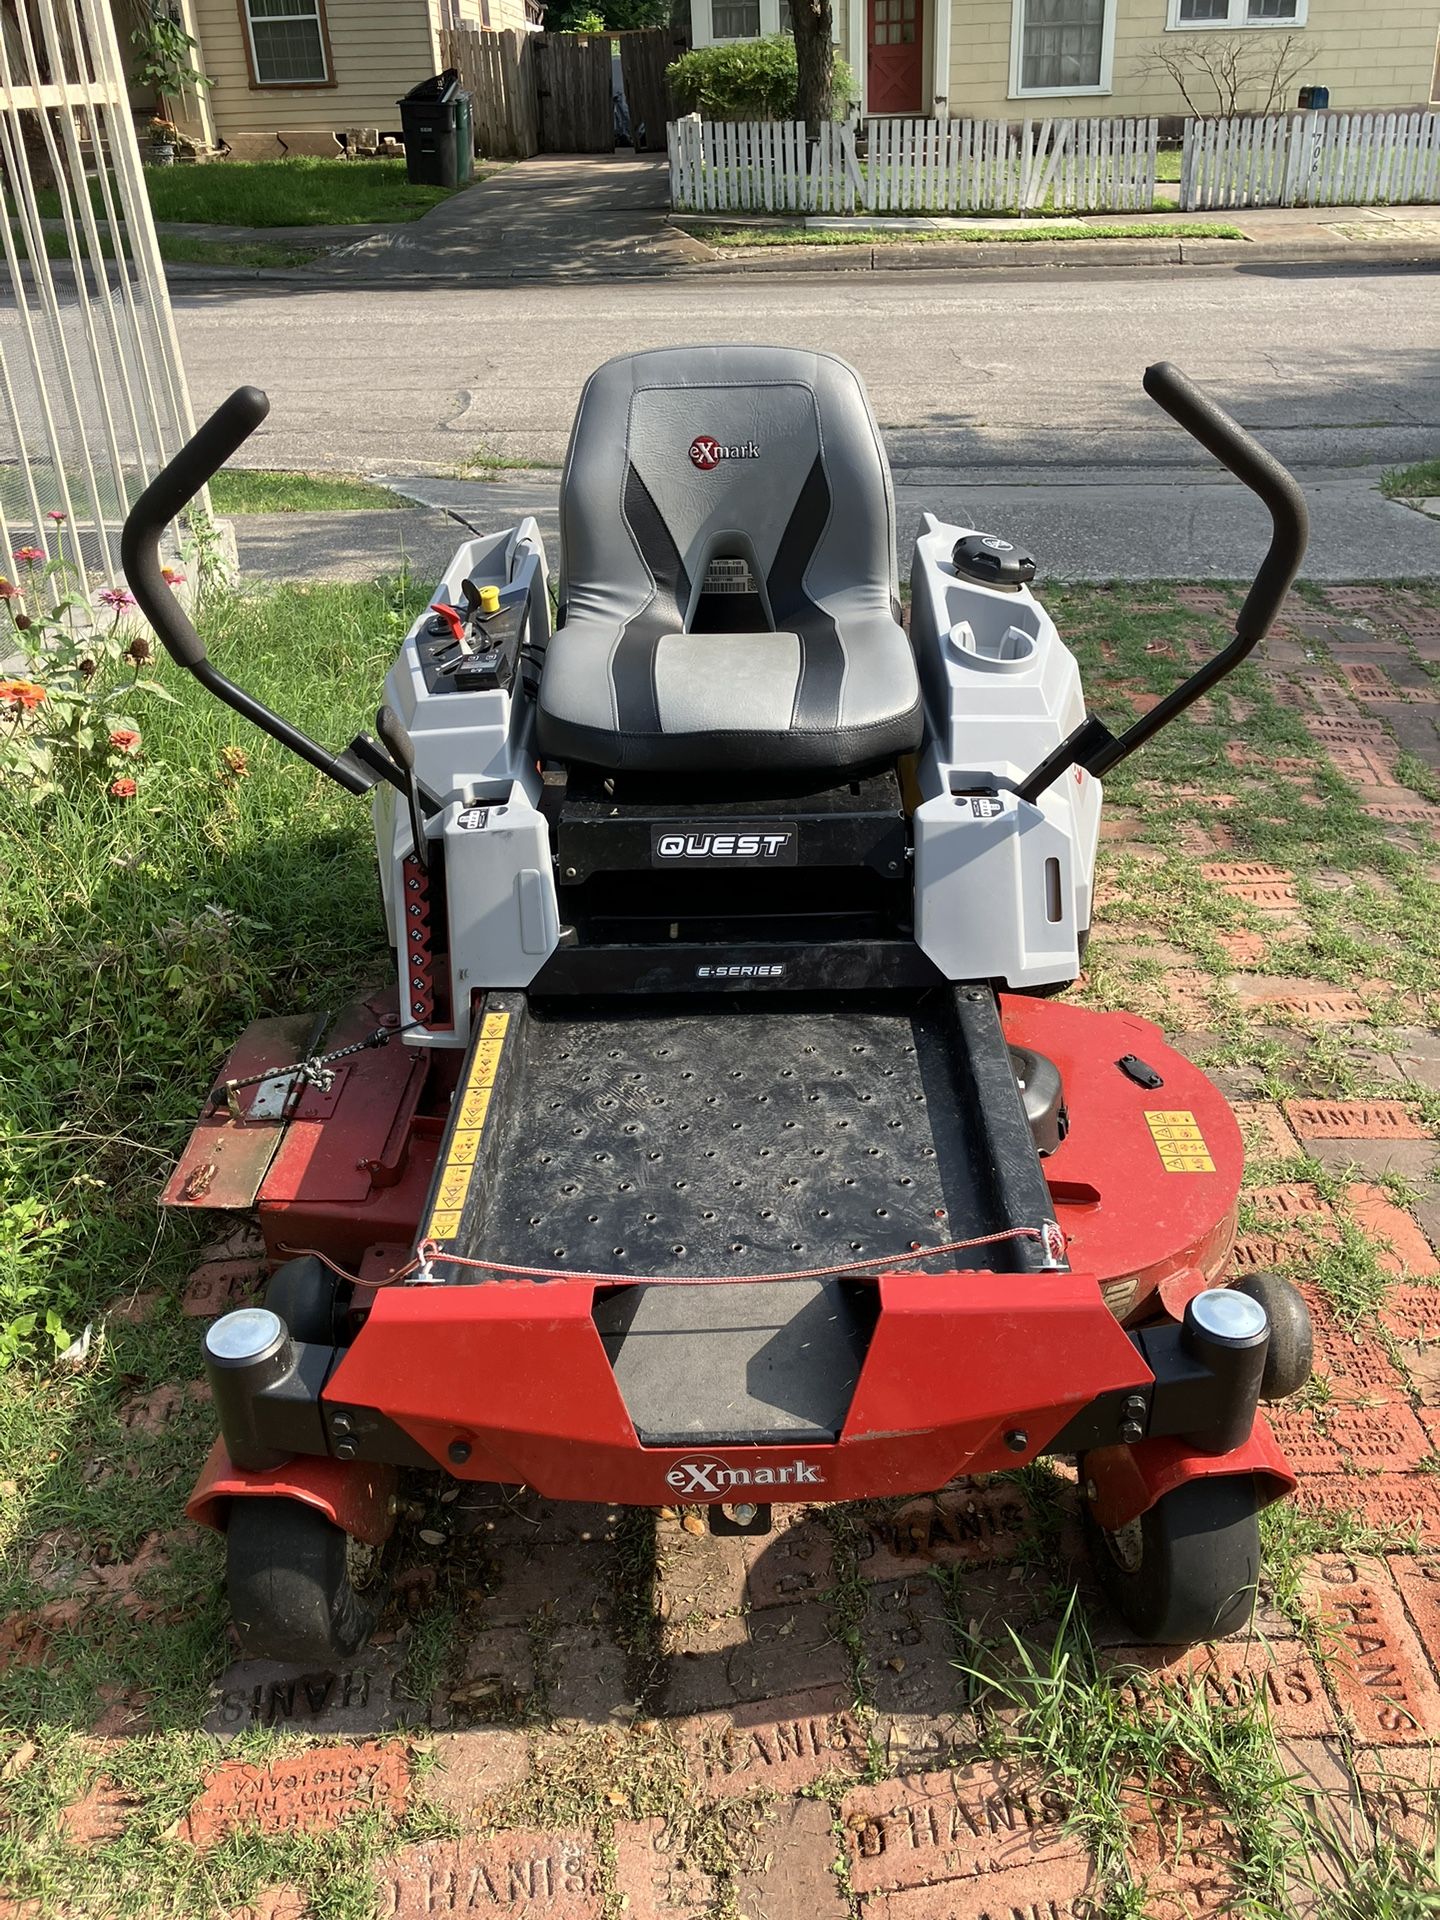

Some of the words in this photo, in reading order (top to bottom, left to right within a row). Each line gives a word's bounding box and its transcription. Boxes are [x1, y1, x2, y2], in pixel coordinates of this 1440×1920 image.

[1312, 133, 1322, 173] 706
[658, 834, 788, 857] QUEST
[409, 904, 421, 915] 3.5
[410, 929, 422, 941] 3.0
[411, 953, 423, 965] 2.5
[412, 978, 424, 989] 2.0
[414, 1002, 425, 1013] 1.5
[665, 1460, 820, 1494] eXmark
